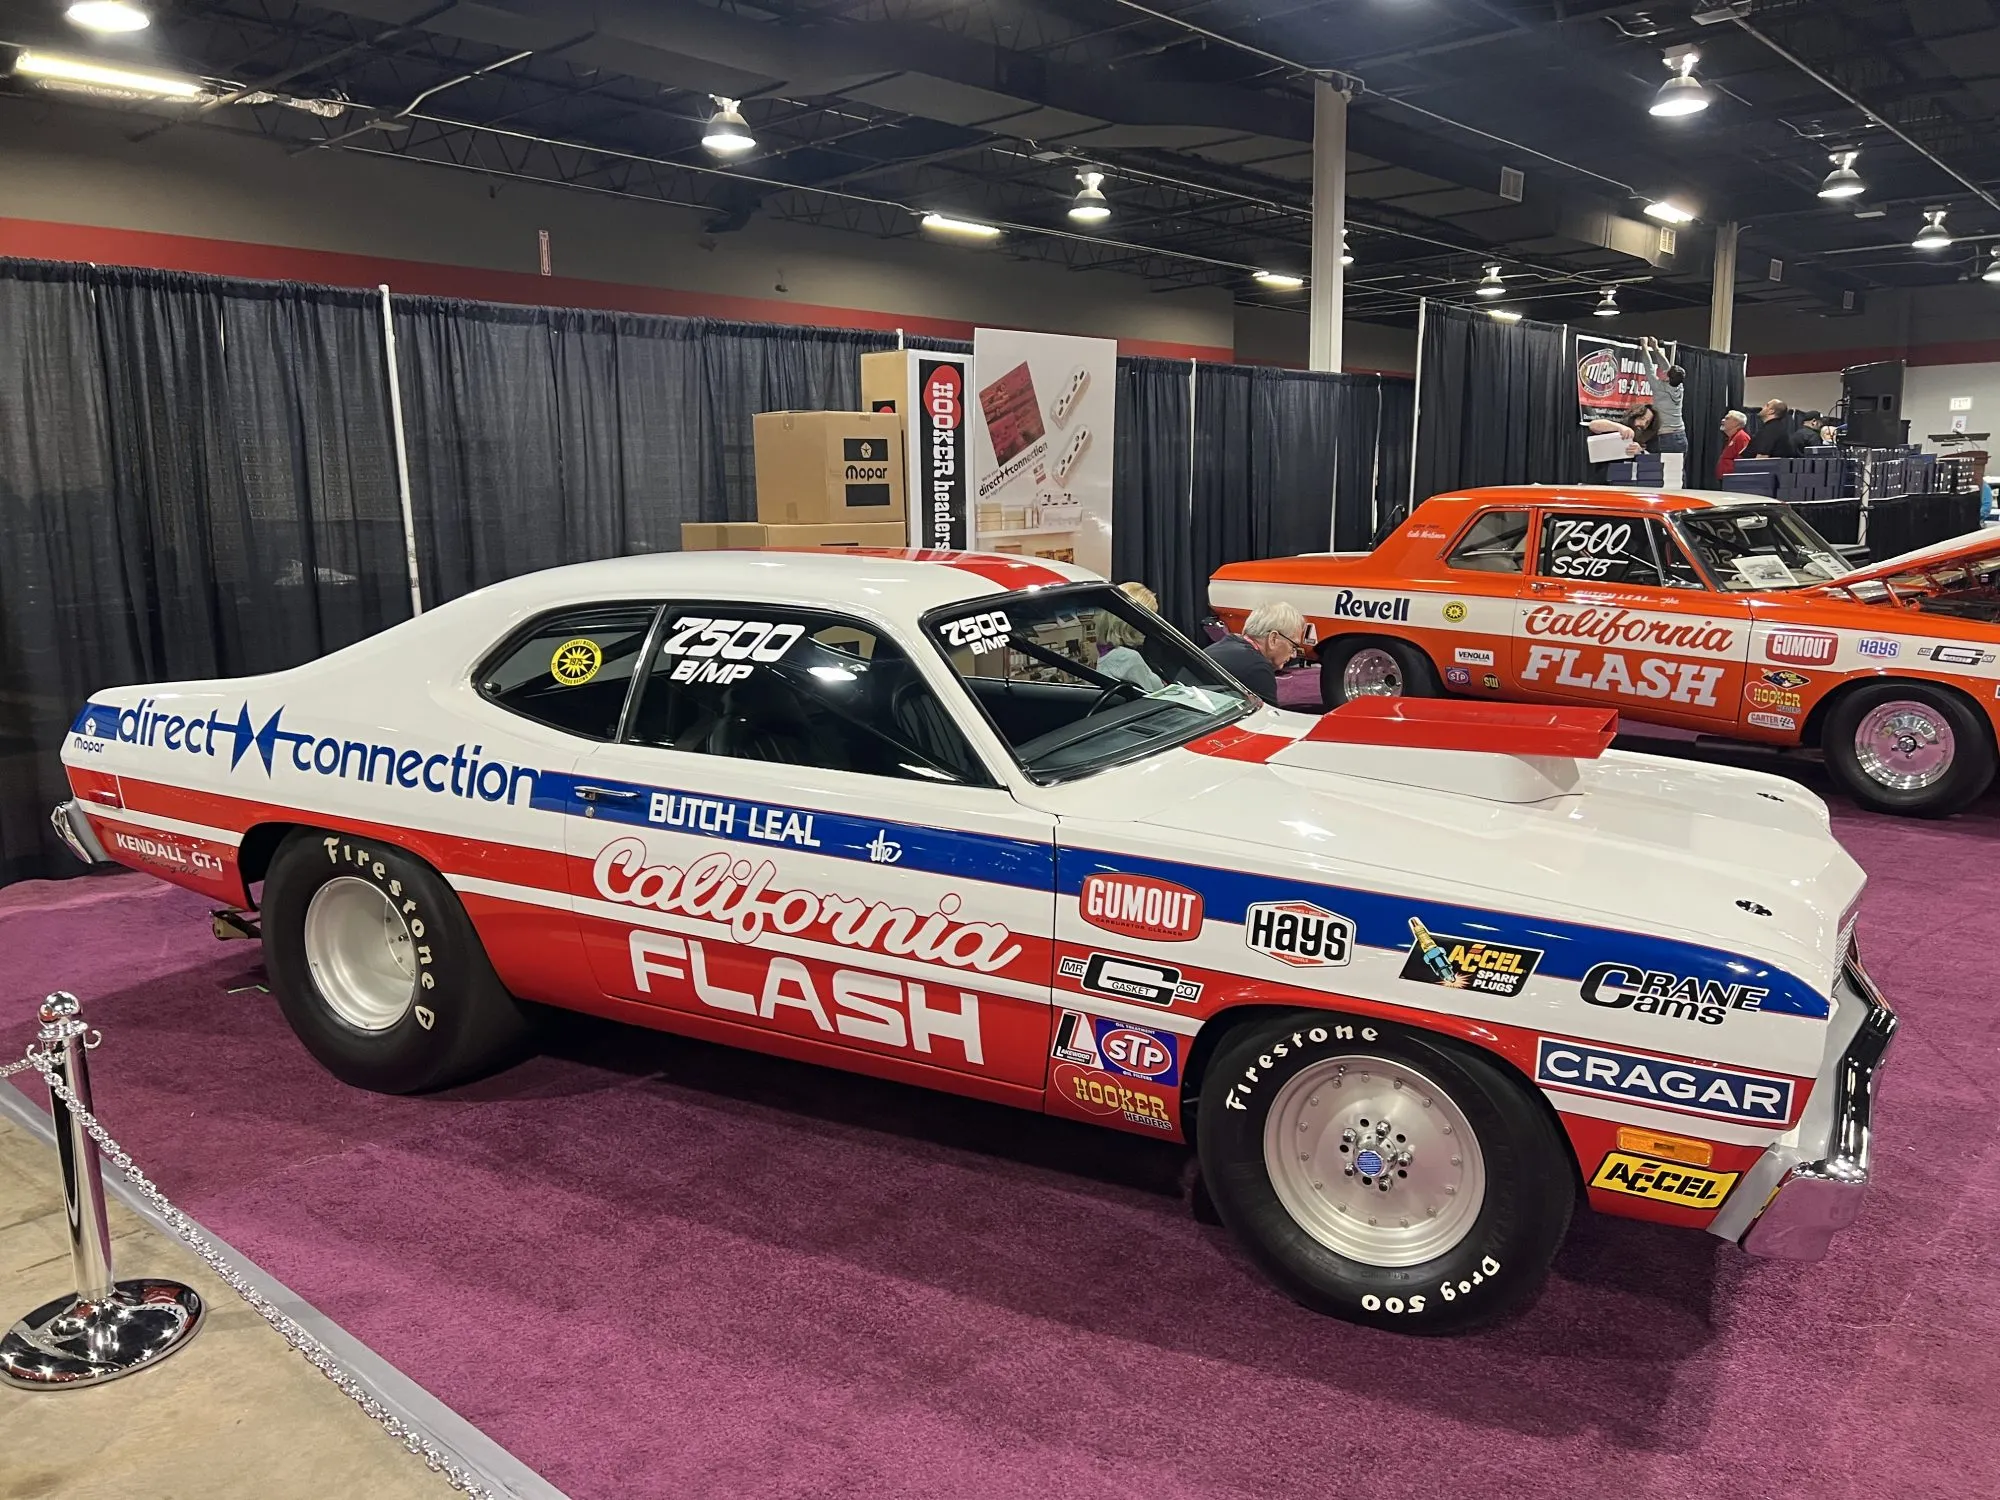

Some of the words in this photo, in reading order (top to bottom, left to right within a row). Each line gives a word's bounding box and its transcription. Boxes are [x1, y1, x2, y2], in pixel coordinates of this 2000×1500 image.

[932, 382, 954, 478] HOOKER
[933, 480, 955, 552] headers
[1551, 520, 1632, 555] 7500
[1334, 590, 1411, 622] Revell
[663, 616, 806, 663] 7500
[939, 610, 1013, 647] 7500
[969, 634, 1010, 656] B/MP
[1525, 604, 1733, 652] California
[569, 657, 584, 667] 1975
[1771, 634, 1832, 659] GUMOUT
[669, 657, 755, 685] B/MP
[1450, 671, 1466, 681] STP
[1520, 644, 1725, 707] FLASH
[1754, 687, 1801, 708] HOOKER
[1750, 713, 1779, 724] CARTER
[118, 698, 220, 758] direct
[292, 732, 542, 808] connection
[649, 791, 735, 835] BUTCH
[747, 805, 821, 848] LEAL
[115, 832, 188, 864] KENDALL
[191, 850, 223, 873] GT-1
[866, 829, 902, 863] the
[323, 836, 436, 991] Firestone
[593, 836, 1023, 973] California
[1087, 878, 1197, 932] GUMOUT
[1095, 917, 1145, 931] CARBURETOR
[1147, 926, 1184, 937] CLEANER
[1447, 943, 1524, 975] ACCEL
[1476, 969, 1520, 985] SPARK
[628, 929, 985, 1066] FLASH
[1111, 981, 1150, 996] GASKET
[1175, 984, 1195, 998] CO.
[1472, 979, 1514, 993] PLUGS
[1579, 961, 1769, 1013] CRANE
[1108, 1034, 1164, 1068] STP
[1225, 1025, 1379, 1111] Firestone
[1072, 1076, 1170, 1121] HOOKER
[1545, 1050, 1781, 1114] CRAGAR
[1124, 1111, 1173, 1131] HEADERS
[1603, 1161, 1721, 1201] ACCEL
[1361, 1294, 1427, 1314] 500
